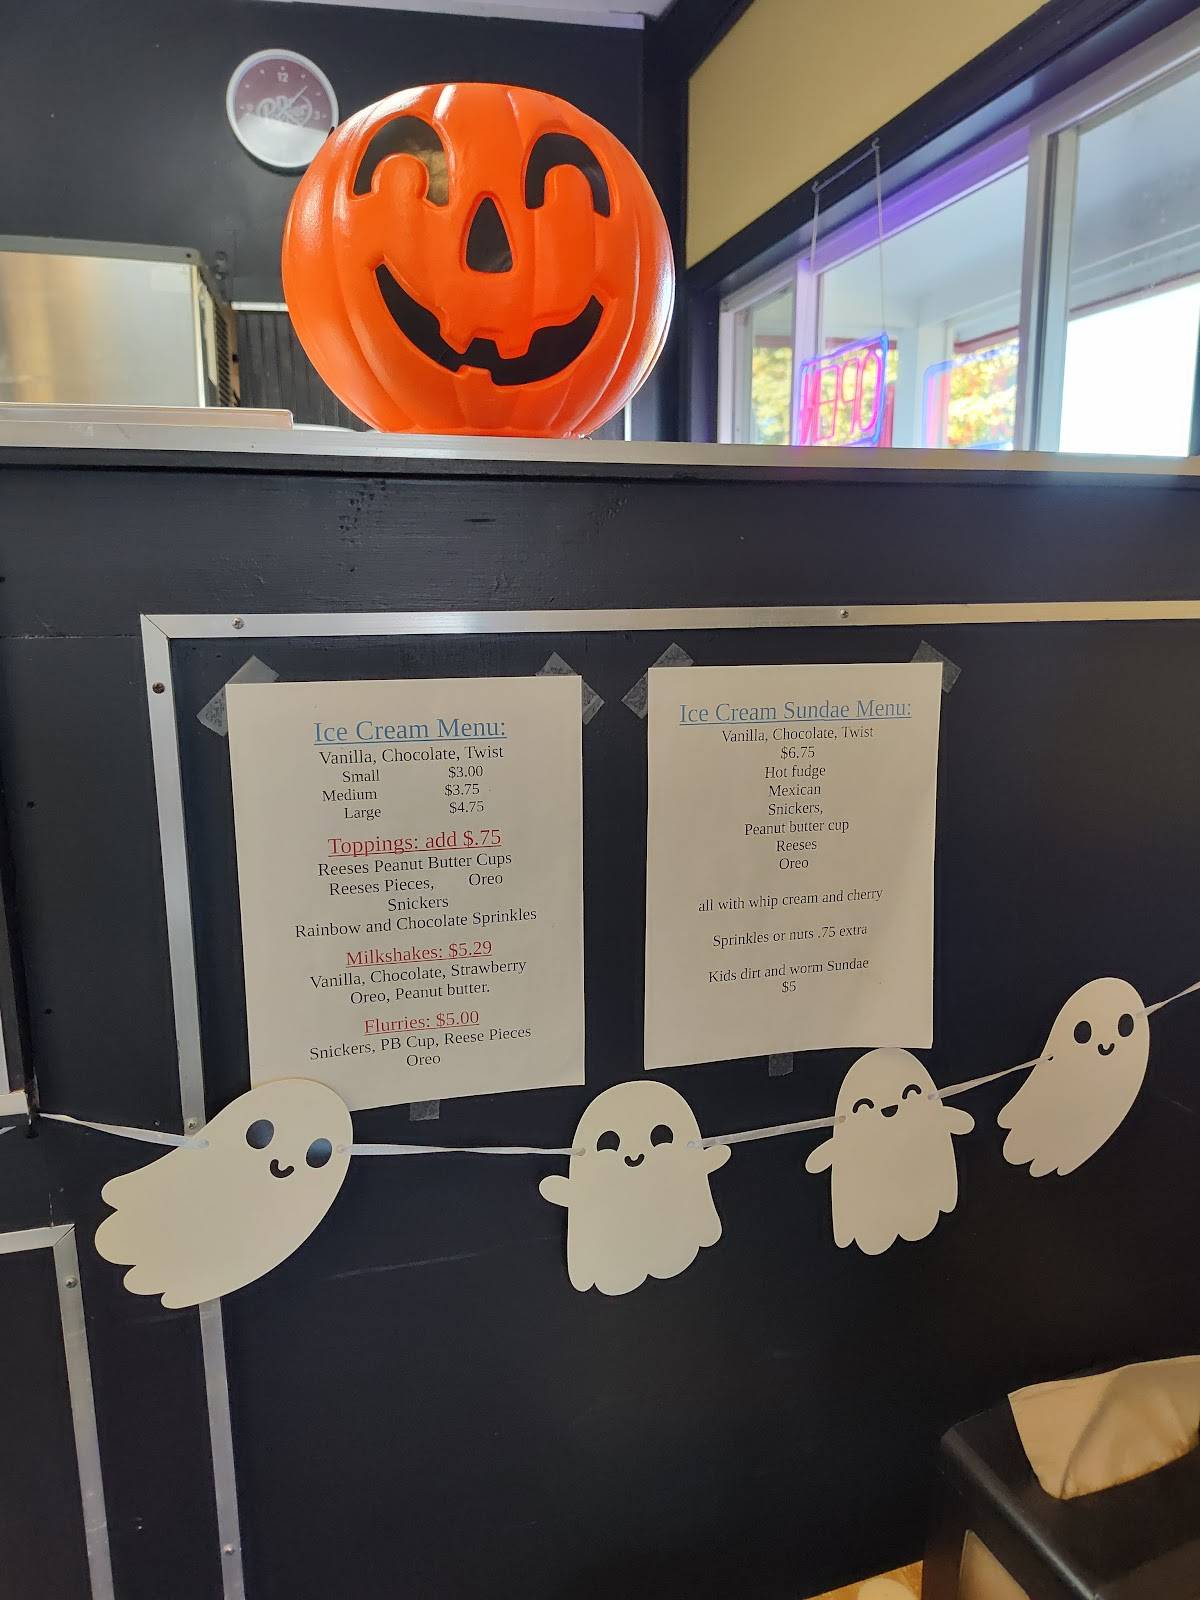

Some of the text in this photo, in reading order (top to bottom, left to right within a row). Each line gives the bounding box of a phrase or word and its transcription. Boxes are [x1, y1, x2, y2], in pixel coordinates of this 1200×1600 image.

[680, 700, 912, 726] Ice Cream Sundae Menu:
[314, 719, 507, 745] Ice Cream Menu:
[722, 726, 873, 743] Vanilla, Chocolate, Twist
[319, 745, 504, 767] Vanilla, Chocolate, Twist
[781, 746, 816, 760] $6.75
[343, 766, 483, 782] Small $3.00
[765, 764, 825, 779] Hot fudge
[322, 784, 479, 801] Medium $3.75
[768, 784, 820, 797] Mexican
[344, 801, 485, 821] Large $4.75
[769, 802, 823, 815] Snickers,
[745, 820, 849, 835] Peanut butter cup
[328, 830, 501, 857] Toppings: add $.75
[776, 840, 816, 853] Reeses
[318, 853, 511, 876] Reeses Peanut Butter Cups
[780, 858, 808, 871] Oreo
[328, 874, 503, 895] Reeses Pieces, Oreo
[388, 896, 448, 911] Snickers
[699, 889, 883, 911] all with whip cream and cherry
[296, 908, 536, 937] Rainbow and Chocolate Sprinkles
[713, 926, 867, 949] Sprinkles or nuts .75 extra
[346, 941, 492, 969] Milkshakes: $5.29
[310, 961, 526, 988] Vanilla, Chocolate, Strawberry
[709, 958, 868, 982] Kids dirt and worm Sundae
[351, 984, 489, 1007] Oreo, Peanut butter.
[782, 981, 796, 993] $5
[364, 1011, 479, 1037] Flurries: $5.00
[310, 1025, 531, 1060] Snickers, PB Cup, Reese Pieces
[407, 1055, 440, 1066] Oreo
